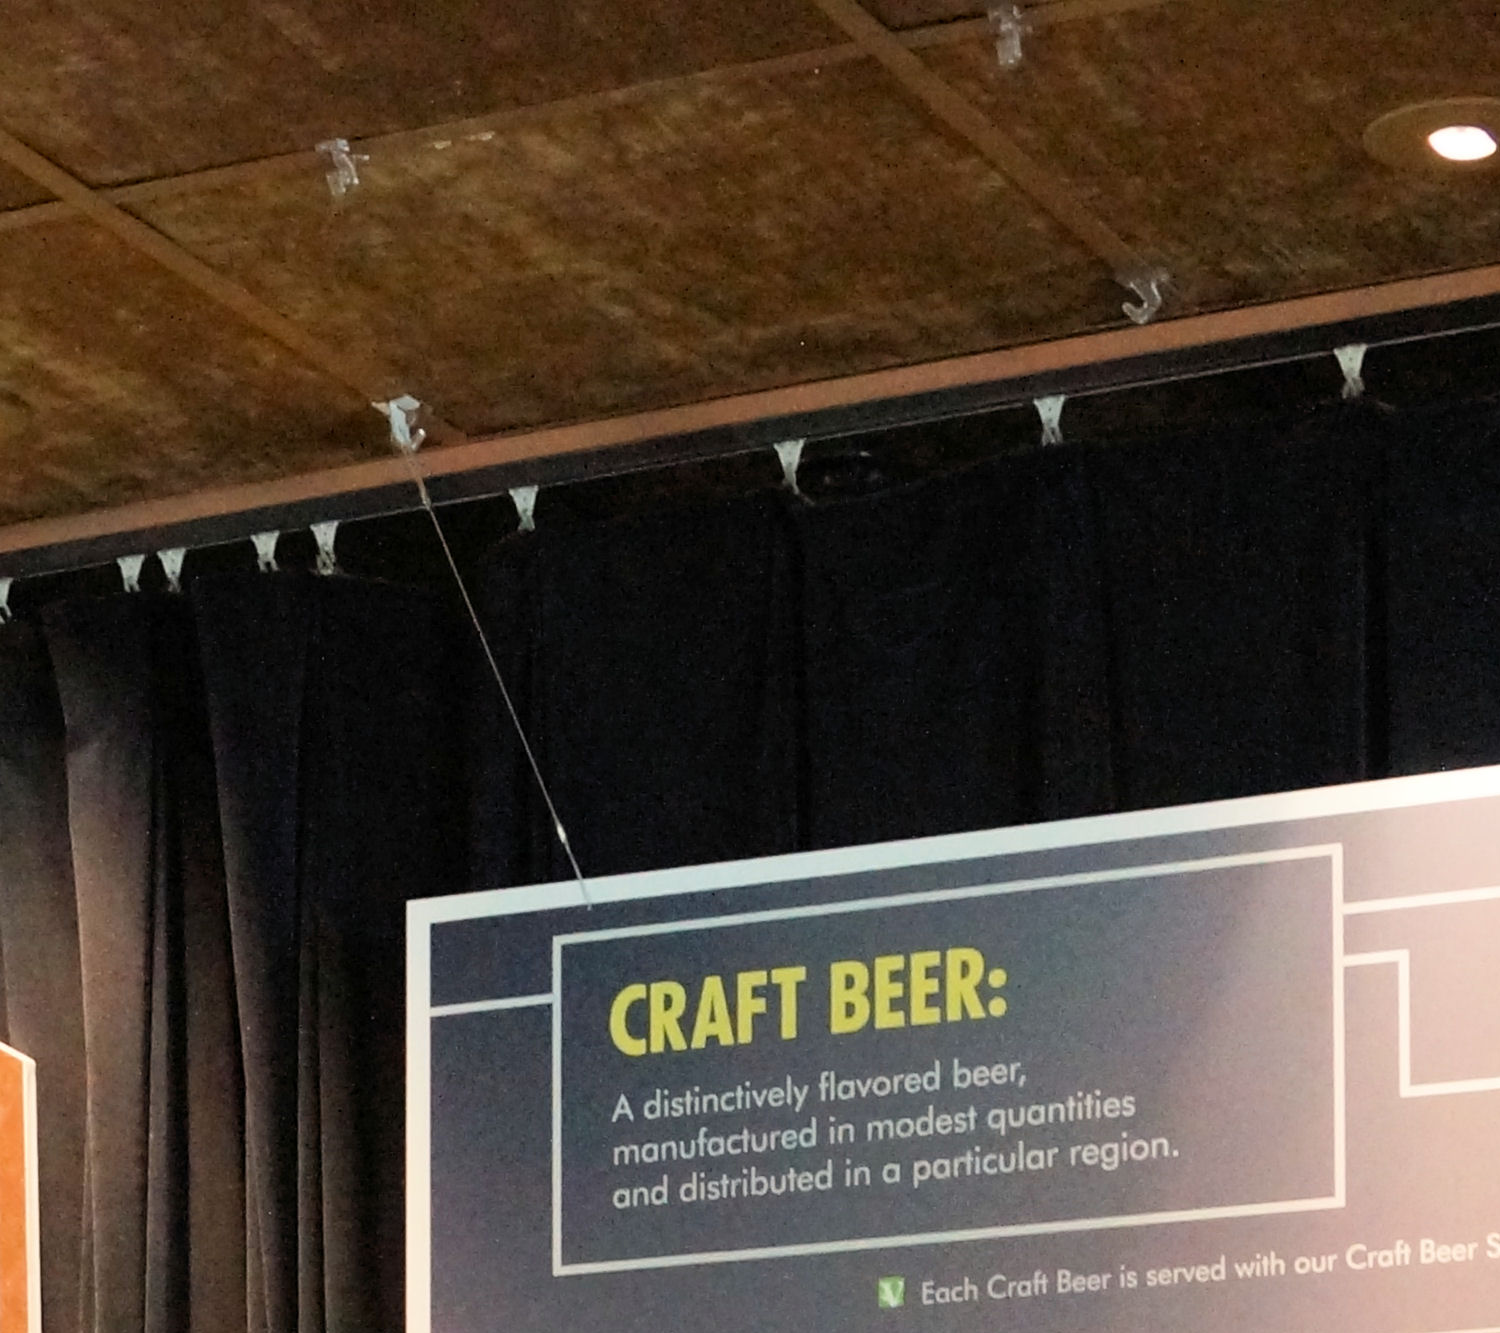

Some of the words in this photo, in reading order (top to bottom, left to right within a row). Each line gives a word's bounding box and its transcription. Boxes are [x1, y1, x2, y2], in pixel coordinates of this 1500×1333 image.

[609, 965, 807, 1057] CRAFT
[830, 947, 1008, 1035] BEER:
[610, 1093, 635, 1124] A
[642, 1074, 809, 1121] distinctively
[817, 1059, 942, 1102] flavored
[952, 1057, 1026, 1089] beer,
[612, 1116, 818, 1167] manufactured
[828, 1115, 855, 1145] in
[866, 1104, 978, 1142] modest
[986, 1089, 1136, 1136] quantities
[611, 1173, 669, 1210] and
[678, 1158, 834, 1204] distributed
[844, 1158, 871, 1187] in
[881, 1162, 902, 1184] a
[912, 1139, 1060, 1189] particular
[1070, 1131, 1180, 1173] region.
[921, 1275, 979, 1306] Each
[986, 1269, 1049, 1300] Craft
[1056, 1268, 1112, 1295] Beer
[1119, 1264, 1139, 1289] is
[1146, 1255, 1226, 1287] served
[1234, 1251, 1286, 1278] with
[1294, 1254, 1338, 1275] our
[1345, 1239, 1411, 1270] Craft
[1420, 1238, 1475, 1264] Beer
